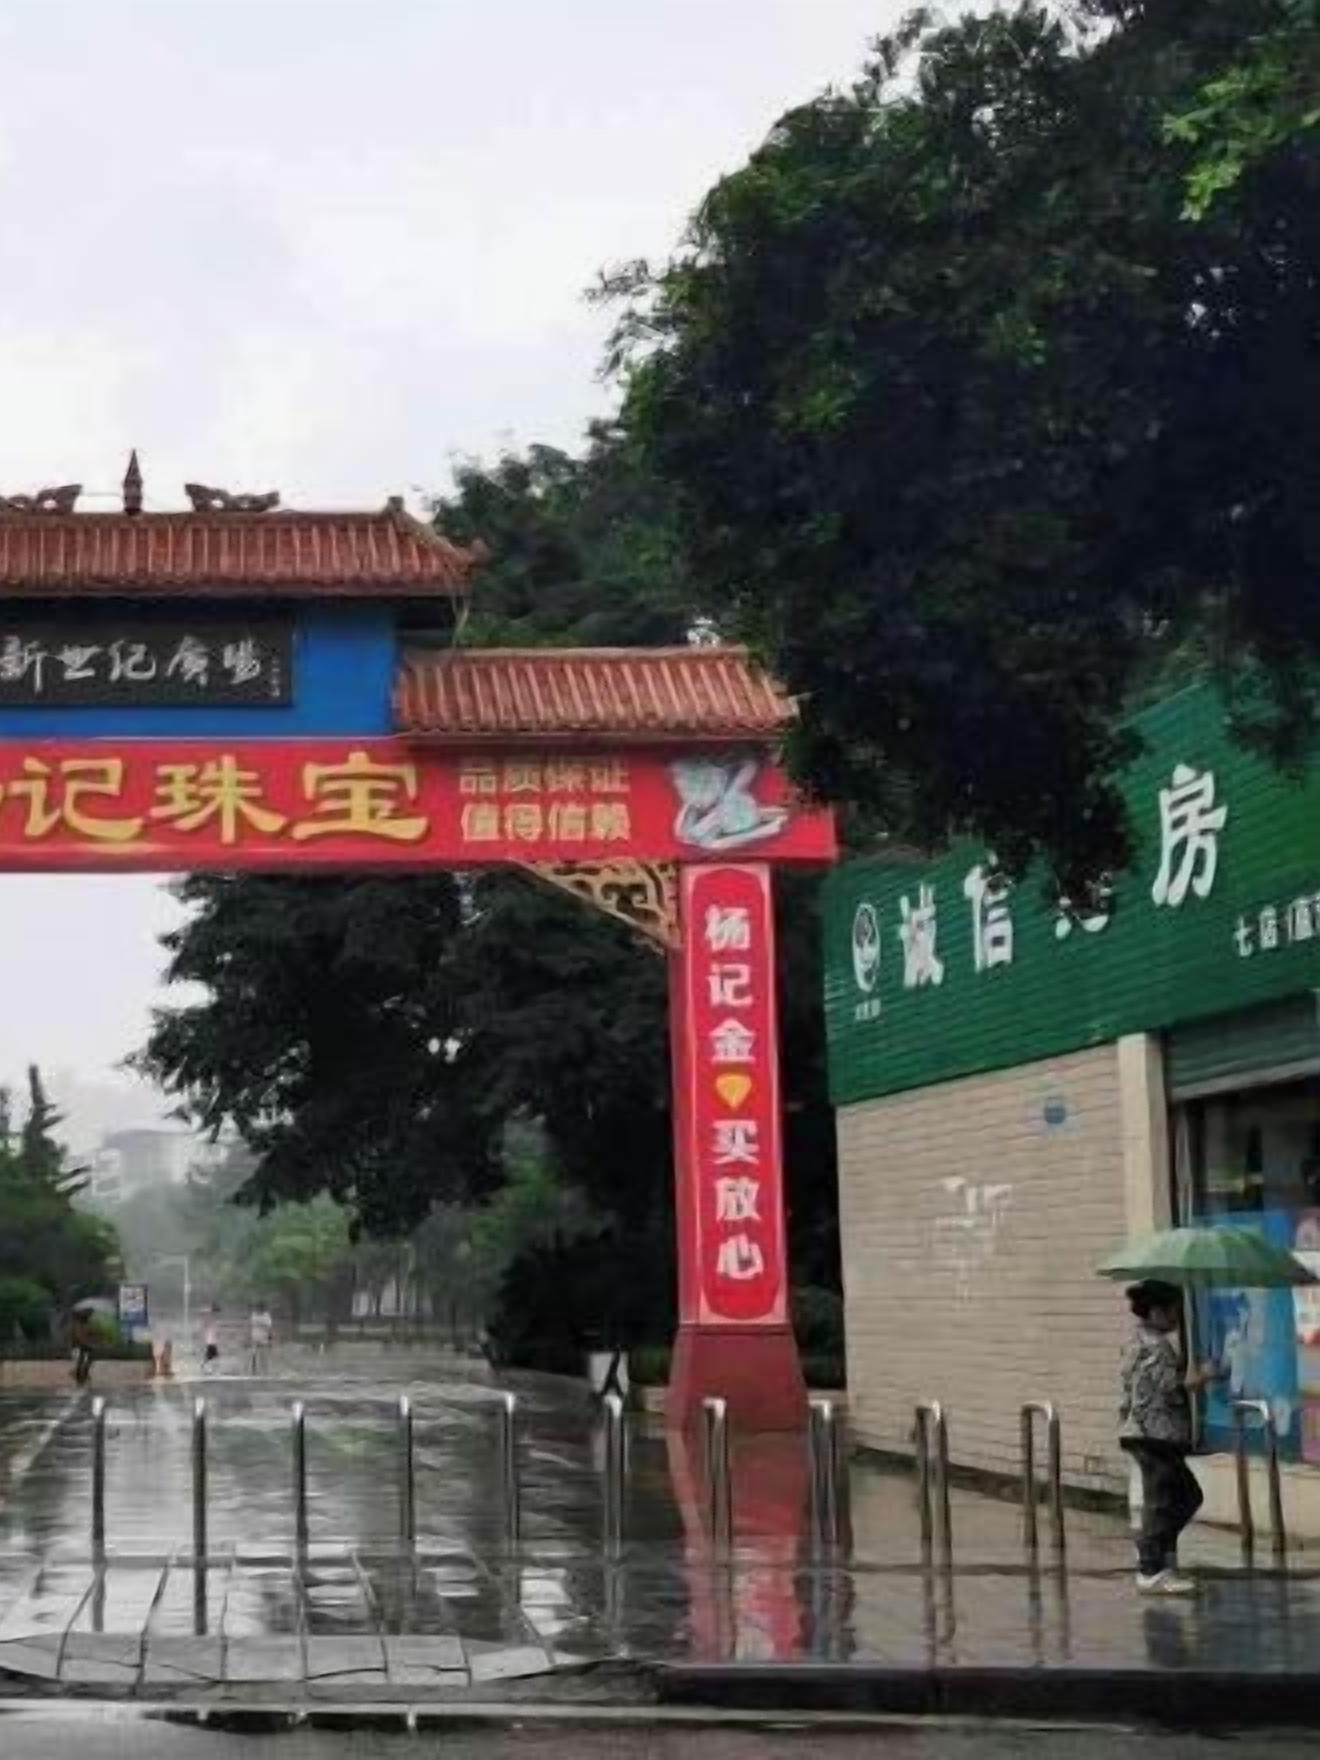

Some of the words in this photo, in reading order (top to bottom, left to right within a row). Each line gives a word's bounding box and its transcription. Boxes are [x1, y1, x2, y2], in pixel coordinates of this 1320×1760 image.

[704, 904, 766, 1281] 杨记金买放心
